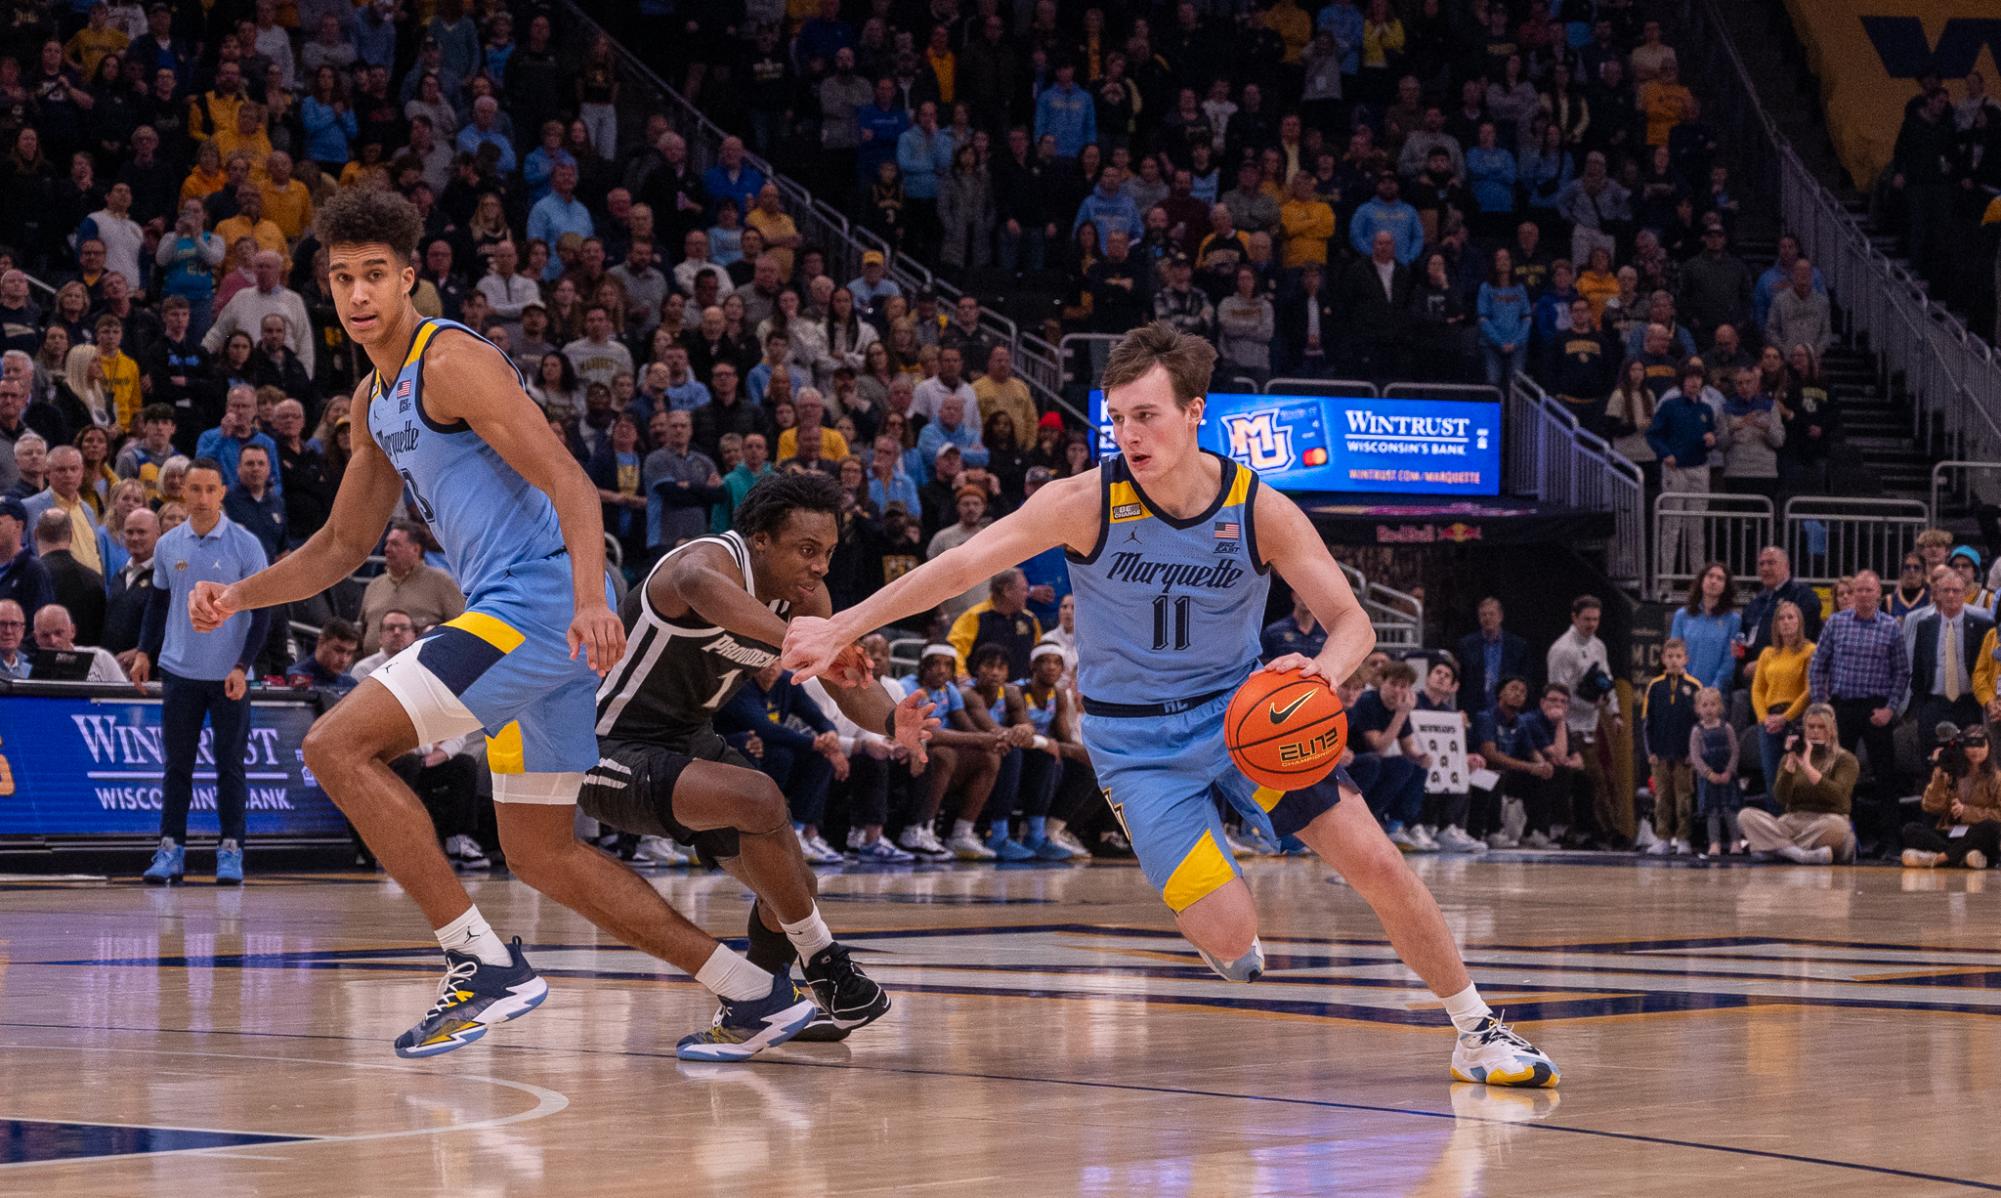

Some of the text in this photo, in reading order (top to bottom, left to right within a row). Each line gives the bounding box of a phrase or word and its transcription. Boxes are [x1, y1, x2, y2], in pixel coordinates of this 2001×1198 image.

[1345, 410, 1471, 436] WINTRUST
[1346, 441, 1429, 455] WISCONSIN'S
[1106, 551, 1245, 593] Marquette
[1152, 594, 1191, 651] 11
[701, 668, 744, 709] 1
[71, 714, 279, 765] WINRST
[1279, 726, 1339, 762] ELITE
[244, 787, 295, 810] ANK.
